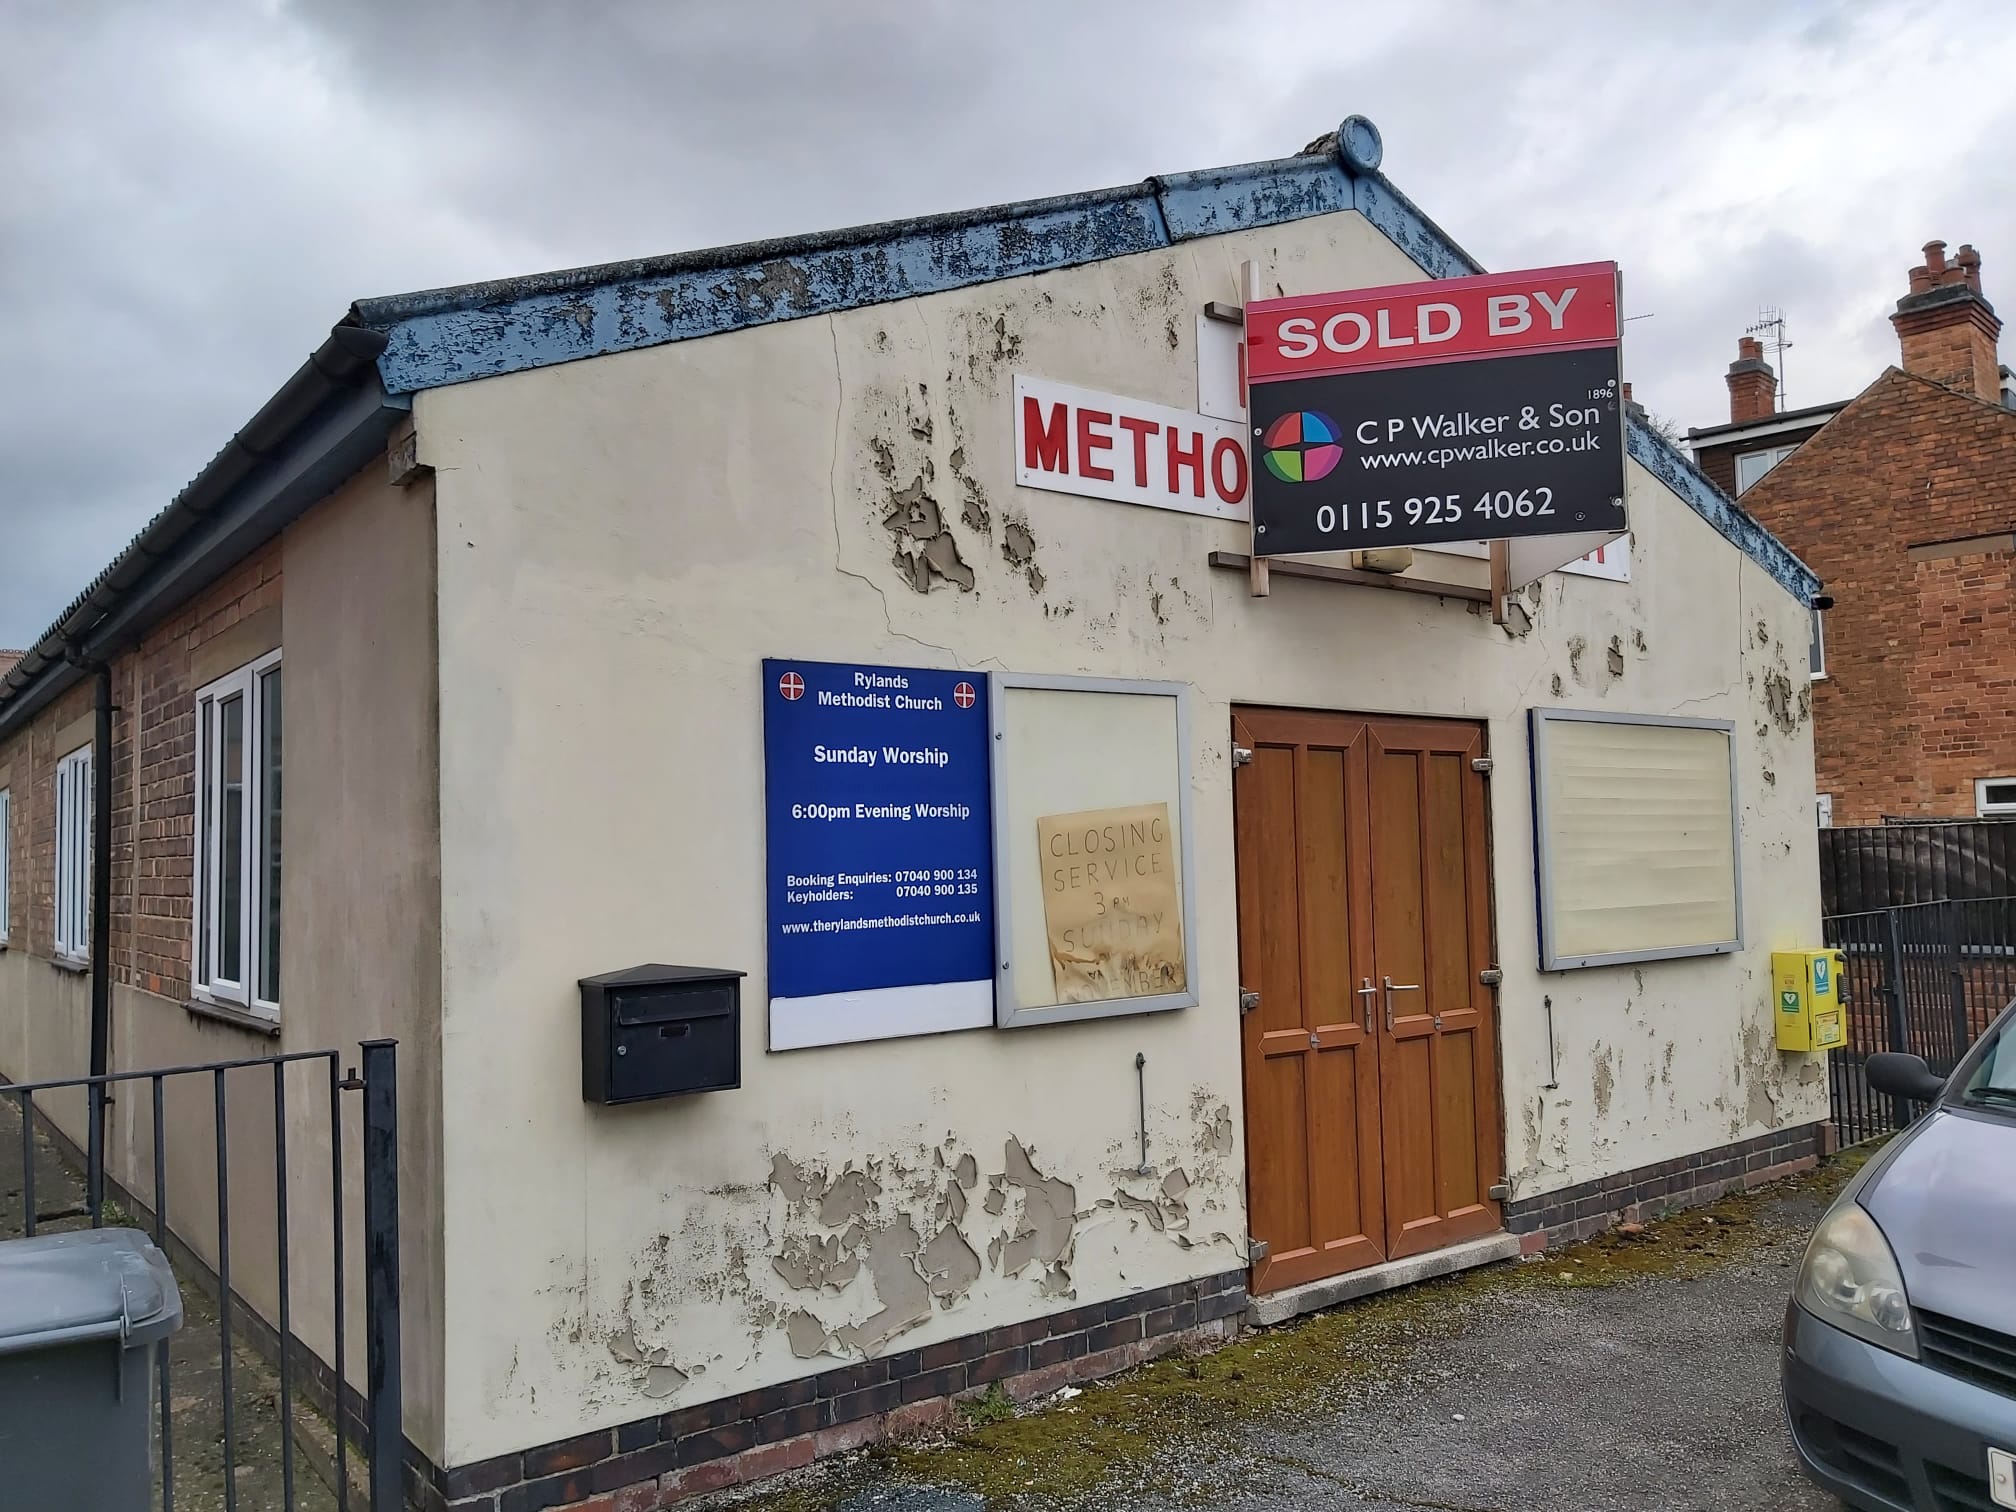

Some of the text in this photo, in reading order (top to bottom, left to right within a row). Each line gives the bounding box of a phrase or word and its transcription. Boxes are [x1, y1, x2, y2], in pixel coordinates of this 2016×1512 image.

[1277, 288, 1578, 359] SOLD BY
[1588, 388, 1614, 400] 1896
[1356, 402, 1600, 445] C P Walker & Son
[1360, 430, 1600, 470] www.cpwalker.co.uk
[1316, 487, 1556, 533] 0115 925 4062
[854, 671, 909, 690] Rylands
[818, 691, 942, 711] Methodist Church
[814, 745, 949, 768] Sunday Worship
[791, 803, 970, 822] 6:00pm Evening Worship
[1049, 817, 1164, 858] CLOSING
[787, 868, 978, 888] Booking Enquiries: 07040 900 134
[1053, 852, 1163, 893] SERVICE
[787, 883, 978, 905] Keyholders: 07040 900 135
[1094, 891, 1106, 916] 3
[782, 911, 981, 934] www.therylandsmethodistchurch.co.uk
